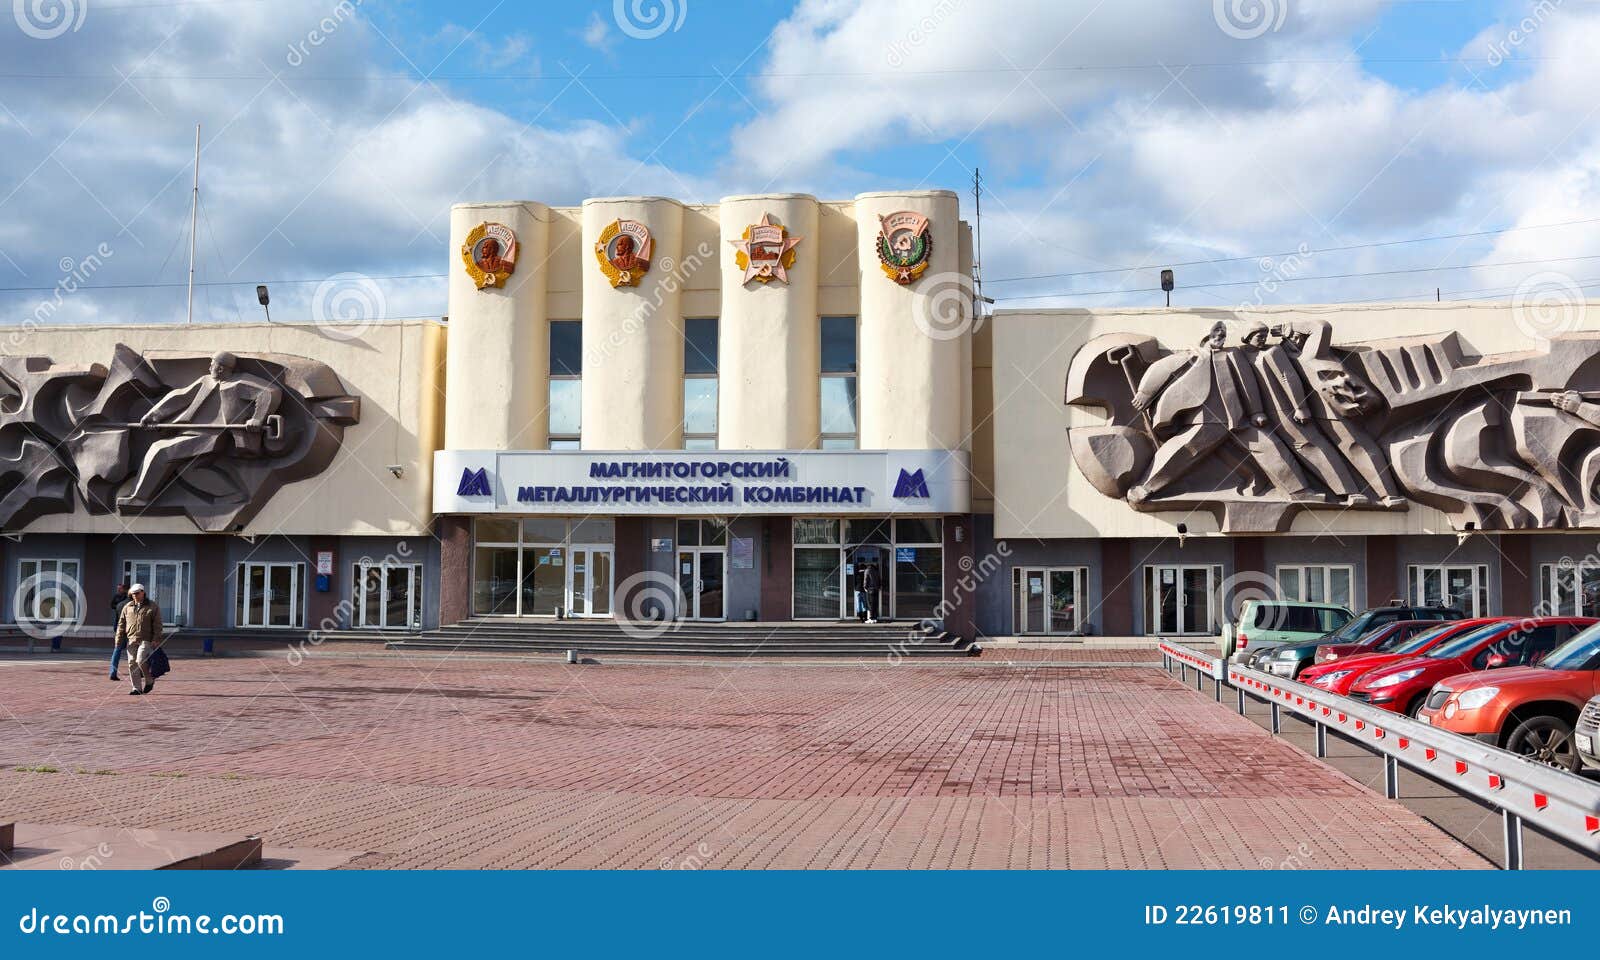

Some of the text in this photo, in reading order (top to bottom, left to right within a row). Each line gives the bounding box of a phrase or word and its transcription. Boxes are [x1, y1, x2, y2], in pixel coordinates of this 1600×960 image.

[589, 457, 789, 478] МАГНИТОГОРСКИЙ
[517, 483, 865, 502] МЕТАЛЛУРГИЧЕСКИЙ КОМБИНАТ
